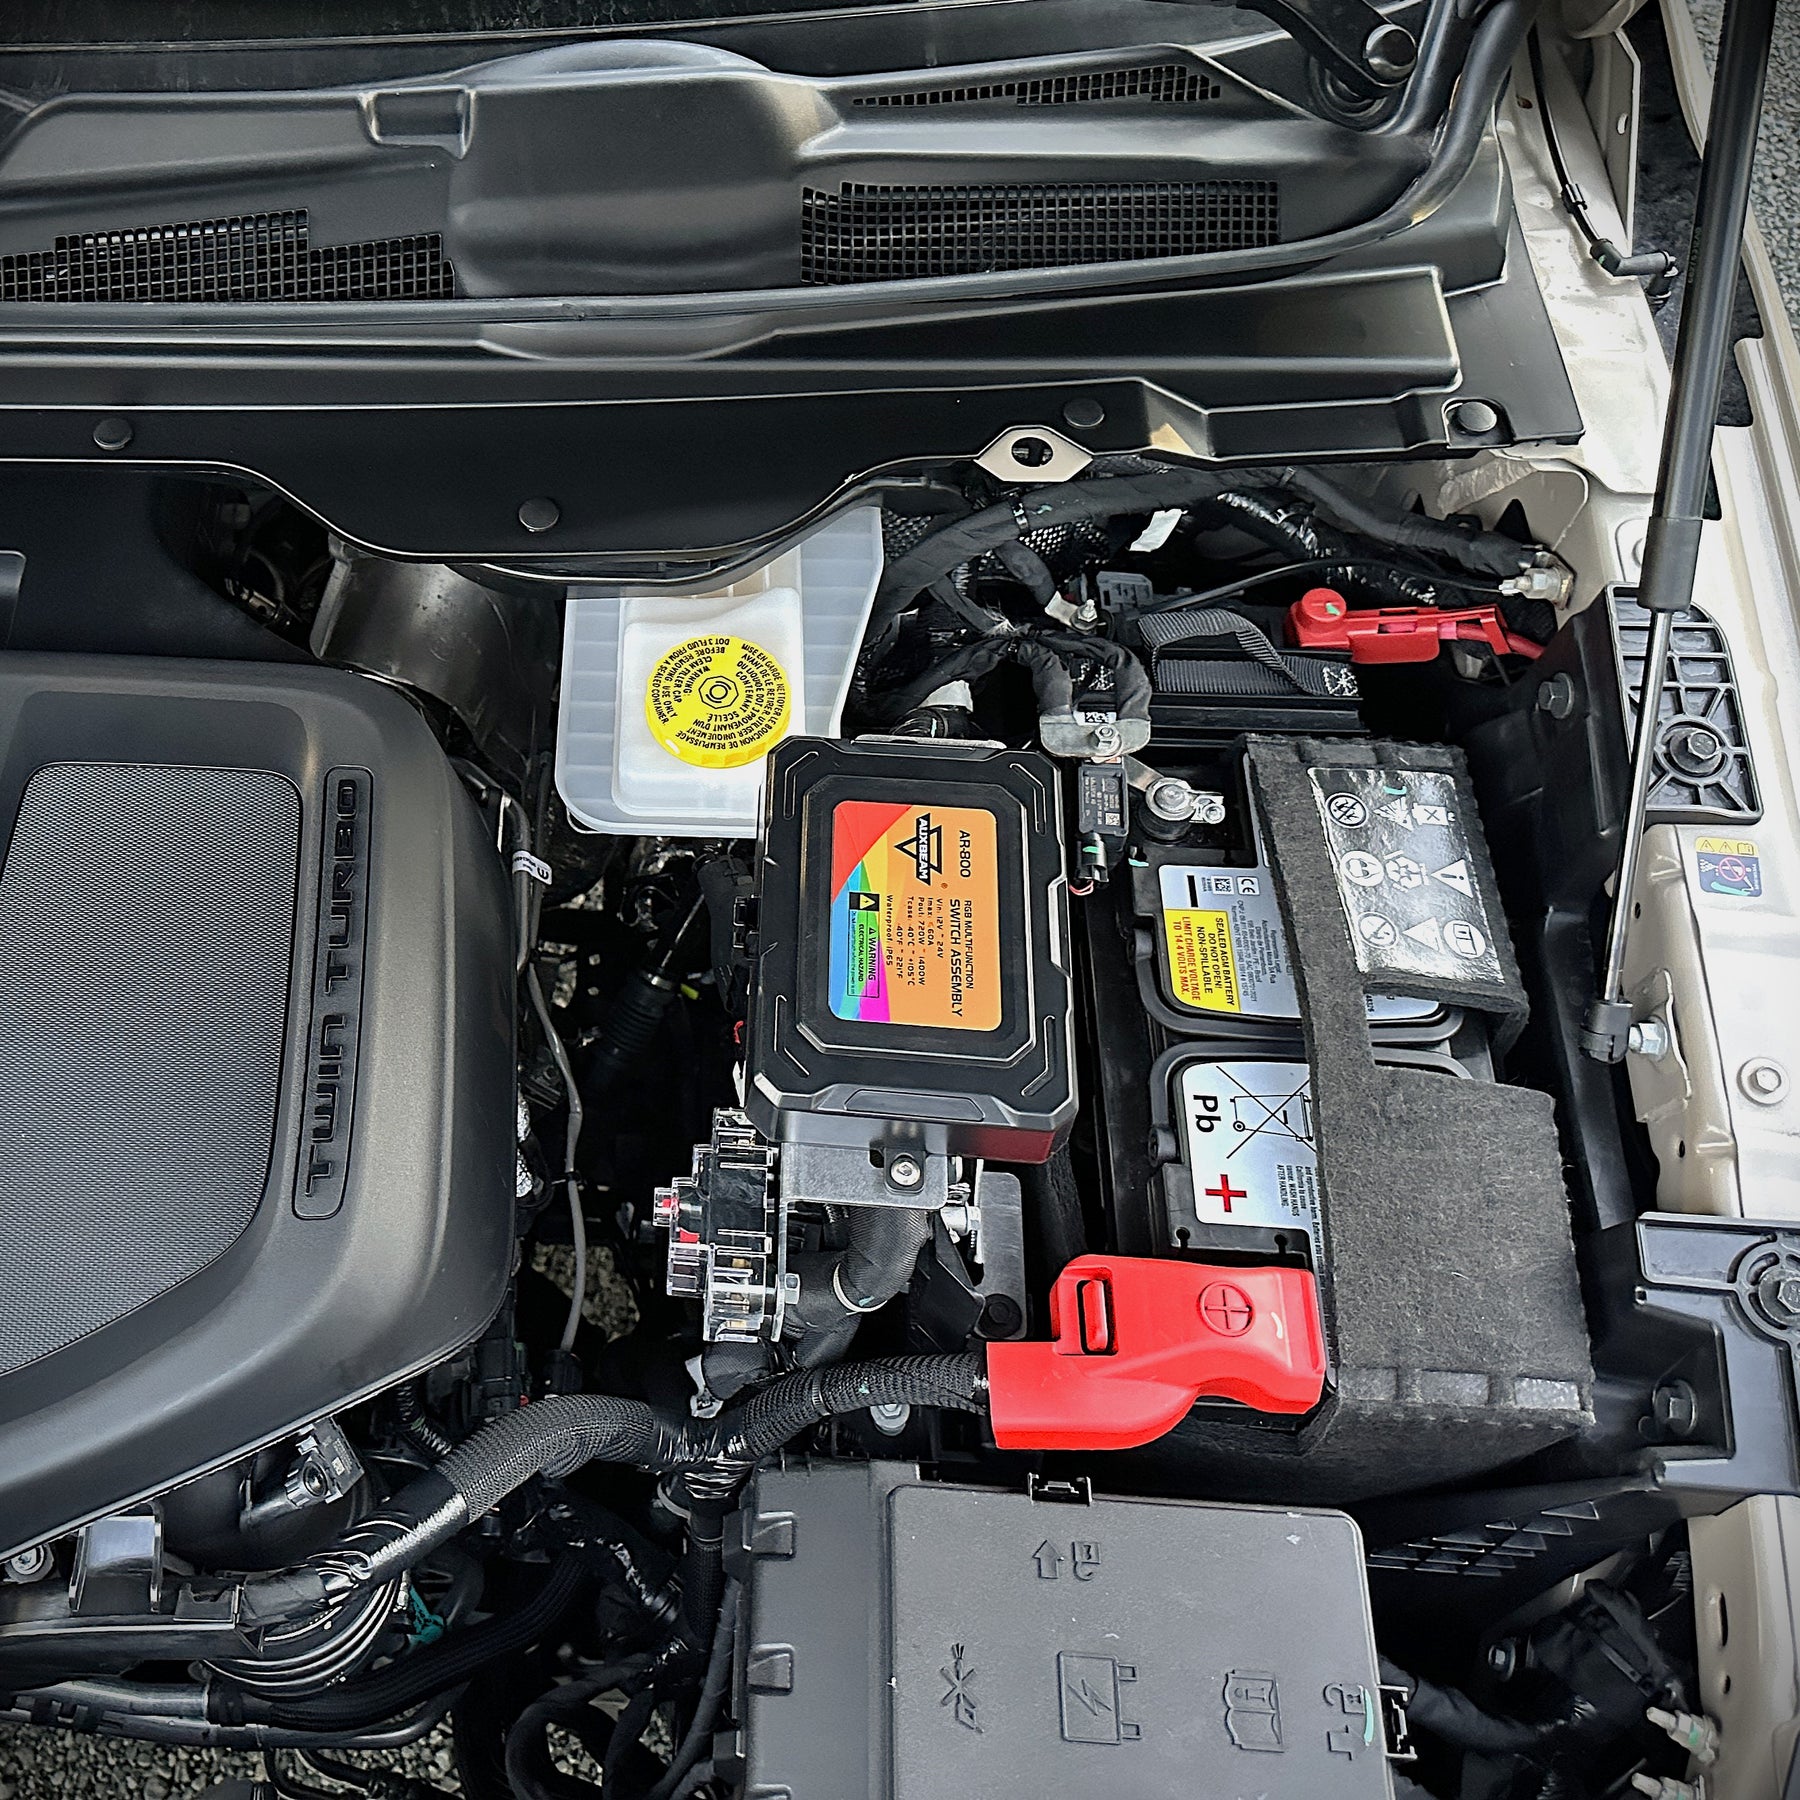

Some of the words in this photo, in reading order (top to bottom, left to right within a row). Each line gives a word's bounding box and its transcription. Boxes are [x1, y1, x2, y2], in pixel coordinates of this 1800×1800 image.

[687, 639, 708, 651] FLUID
[708, 638, 713, 646] 3
[715, 637, 730, 646] DOT
[741, 643, 759, 656] MISE
[668, 647, 687, 661] FROM
[694, 646, 726, 657] BEFORE
[756, 652, 768, 662] EN
[689, 655, 713, 669] CLEAN
[736, 660, 749, 670] DU
[741, 653, 764, 670] AVANT
[765, 661, 783, 681] GARDE
[652, 665, 668, 688] SEALED
[673, 667, 691, 688] FILLER
[746, 667, 765, 692] LIQUIDE
[759, 668, 770, 679] DE
[764, 678, 774, 687] LE
[662, 685, 671, 698] USE
[672, 690, 682, 703] CAP
[735, 670, 754, 713] CONTENANT
[755, 693, 765, 707] DOT
[773, 683, 786, 716] NETTOYER
[663, 700, 678, 718] ONLY
[692, 718, 711, 731] D'UN
[713, 711, 757, 732] PROVENANT
[737, 713, 766, 738] UTILISER
[767, 713, 778, 725] LE
[675, 730, 726, 750] REMPLISSAGE
[686, 727, 737, 741] UNIQUEMENT
[739, 723, 773, 747] BOUCHON
[728, 741, 739, 749] DE
[918, 818, 928, 880] AUXBEAM
[959, 830, 971, 878] AR-800
[322, 779, 359, 996] TURBO
[964, 900, 972, 919] RGB
[950, 899, 961, 945] SWITCH
[1173, 921, 1182, 931] TO
[1182, 916, 1193, 936] LIMIT
[1174, 935, 1184, 950] 14.4
[1208, 933, 1217, 945] DO
[1215, 918, 1227, 949] SEALED
[868, 937, 877, 980] WARNING
[886, 946, 894, 966] IP65
[964, 920, 974, 989] MULTIFUNCTION
[1185, 938, 1197, 967] CHARGE
[1196, 926, 1213, 994] NON-SPILLABLE
[1210, 946, 1219, 963] NOT
[1220, 950, 1230, 968] AGM
[918, 956, 926, 986] 1400W
[1177, 951, 1187, 974] VOLTS
[950, 949, 962, 1017] ASSEMBLY
[1180, 976, 1190, 995] MAX.
[1188, 969, 1201, 1001] VOLTAGE
[1212, 964, 1222, 989] OPEN!
[1223, 969, 1235, 1006] BATTERY
[303, 1013, 347, 1197] TWIN
[1193, 1094, 1222, 1134] Pb
[1277, 1164, 1287, 1180] AFTER
[1305, 1166, 1314, 1176] and
[1288, 1183, 1297, 1198] WASH
[1305, 1176, 1317, 1205] reproductive
[1290, 1199, 1300, 1217] HANDS
